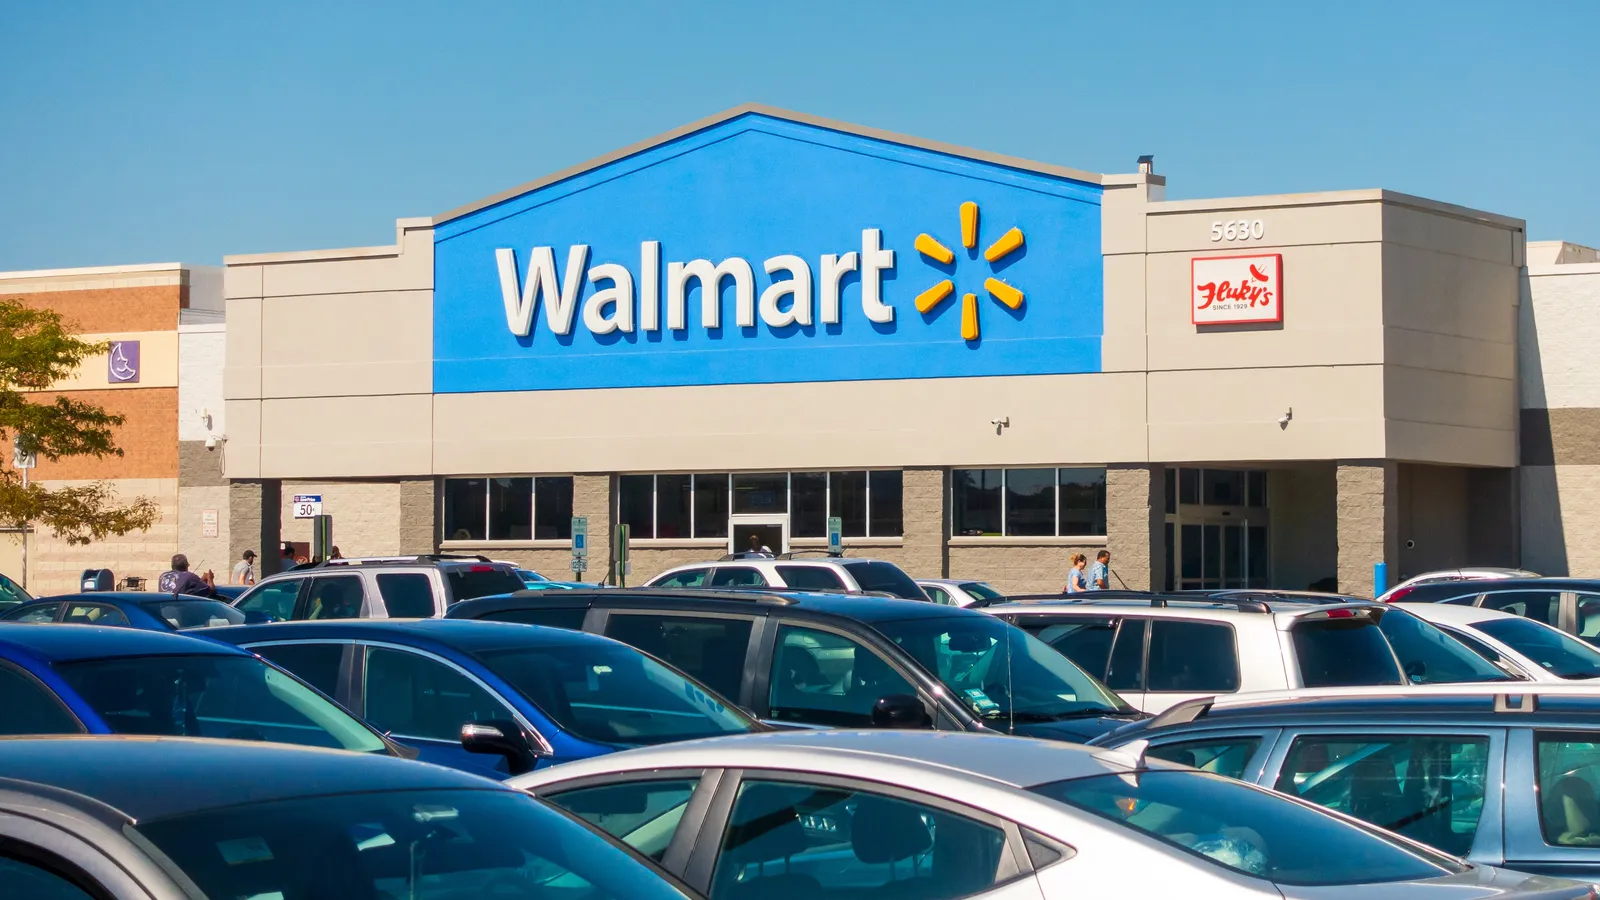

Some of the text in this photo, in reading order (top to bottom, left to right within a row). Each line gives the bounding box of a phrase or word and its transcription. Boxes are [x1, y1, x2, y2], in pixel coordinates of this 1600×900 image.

[1211, 219, 1264, 242] 5630
[495, 228, 895, 336] Walmart
[1197, 280, 1273, 309] Fluky's
